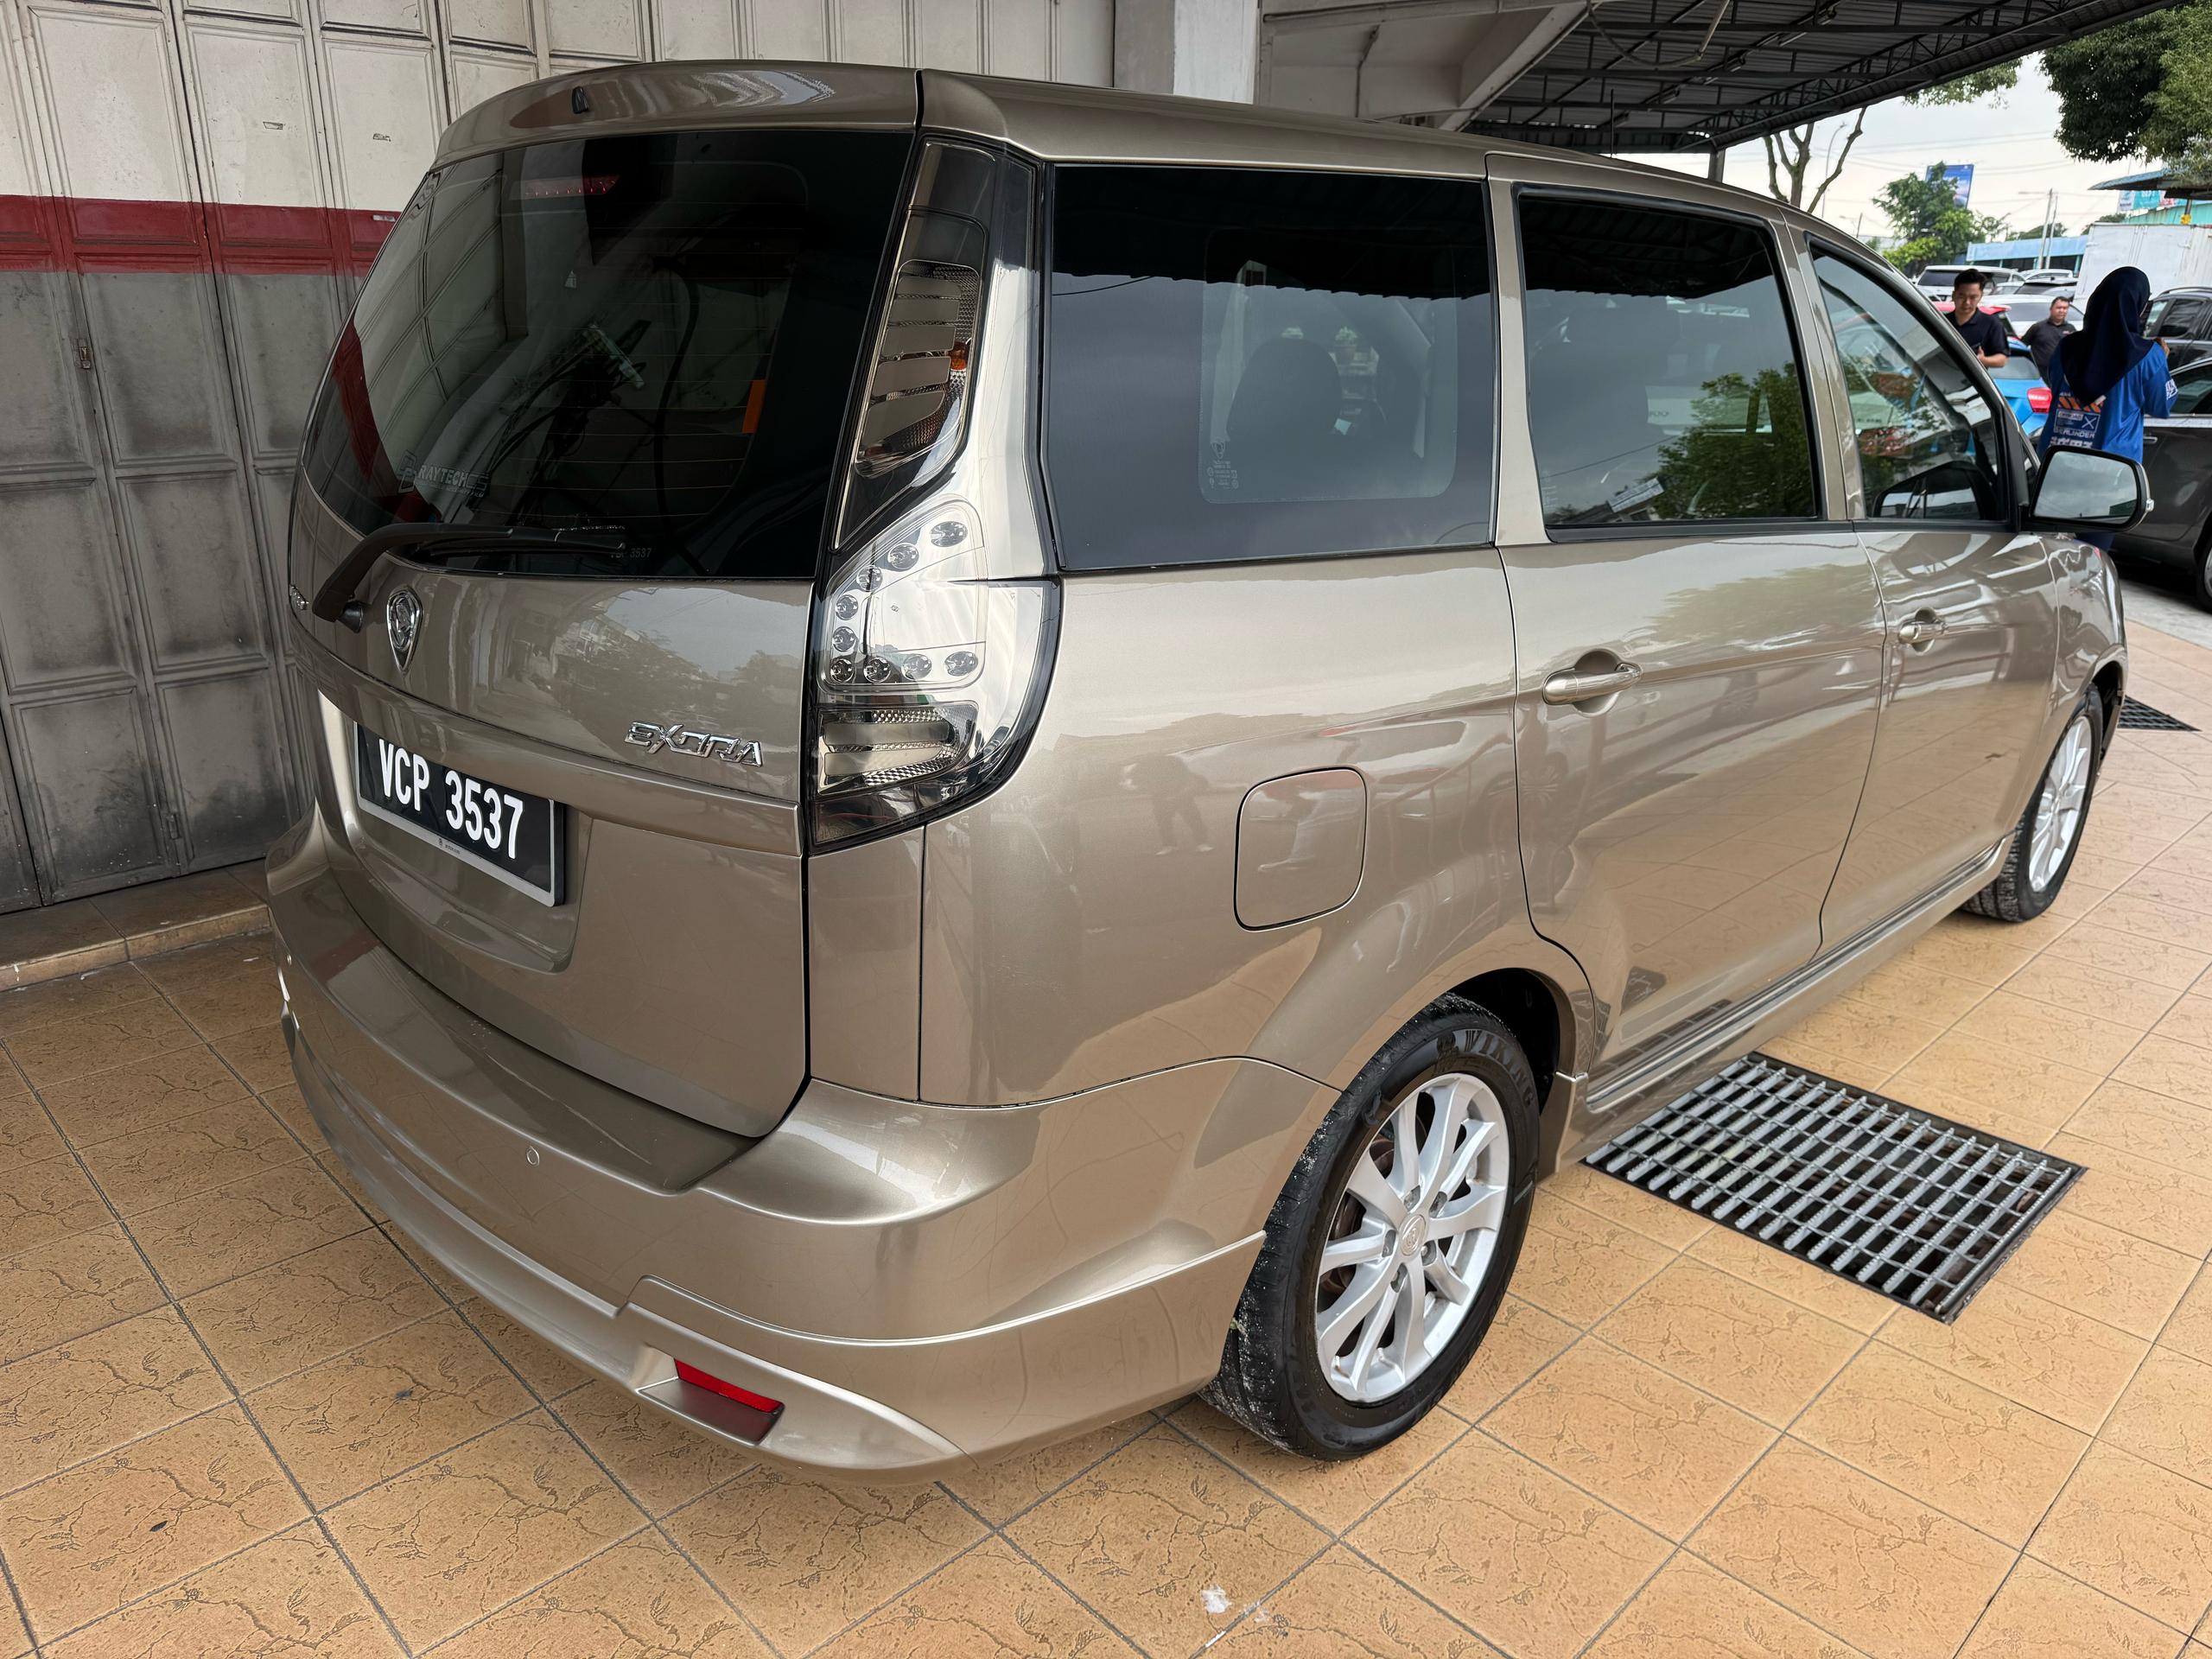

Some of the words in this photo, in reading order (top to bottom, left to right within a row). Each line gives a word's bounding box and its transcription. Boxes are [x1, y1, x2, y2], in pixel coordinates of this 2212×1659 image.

[625, 721, 763, 767] EXORA
[378, 739, 429, 811] VCP
[445, 770, 524, 859] 3537
